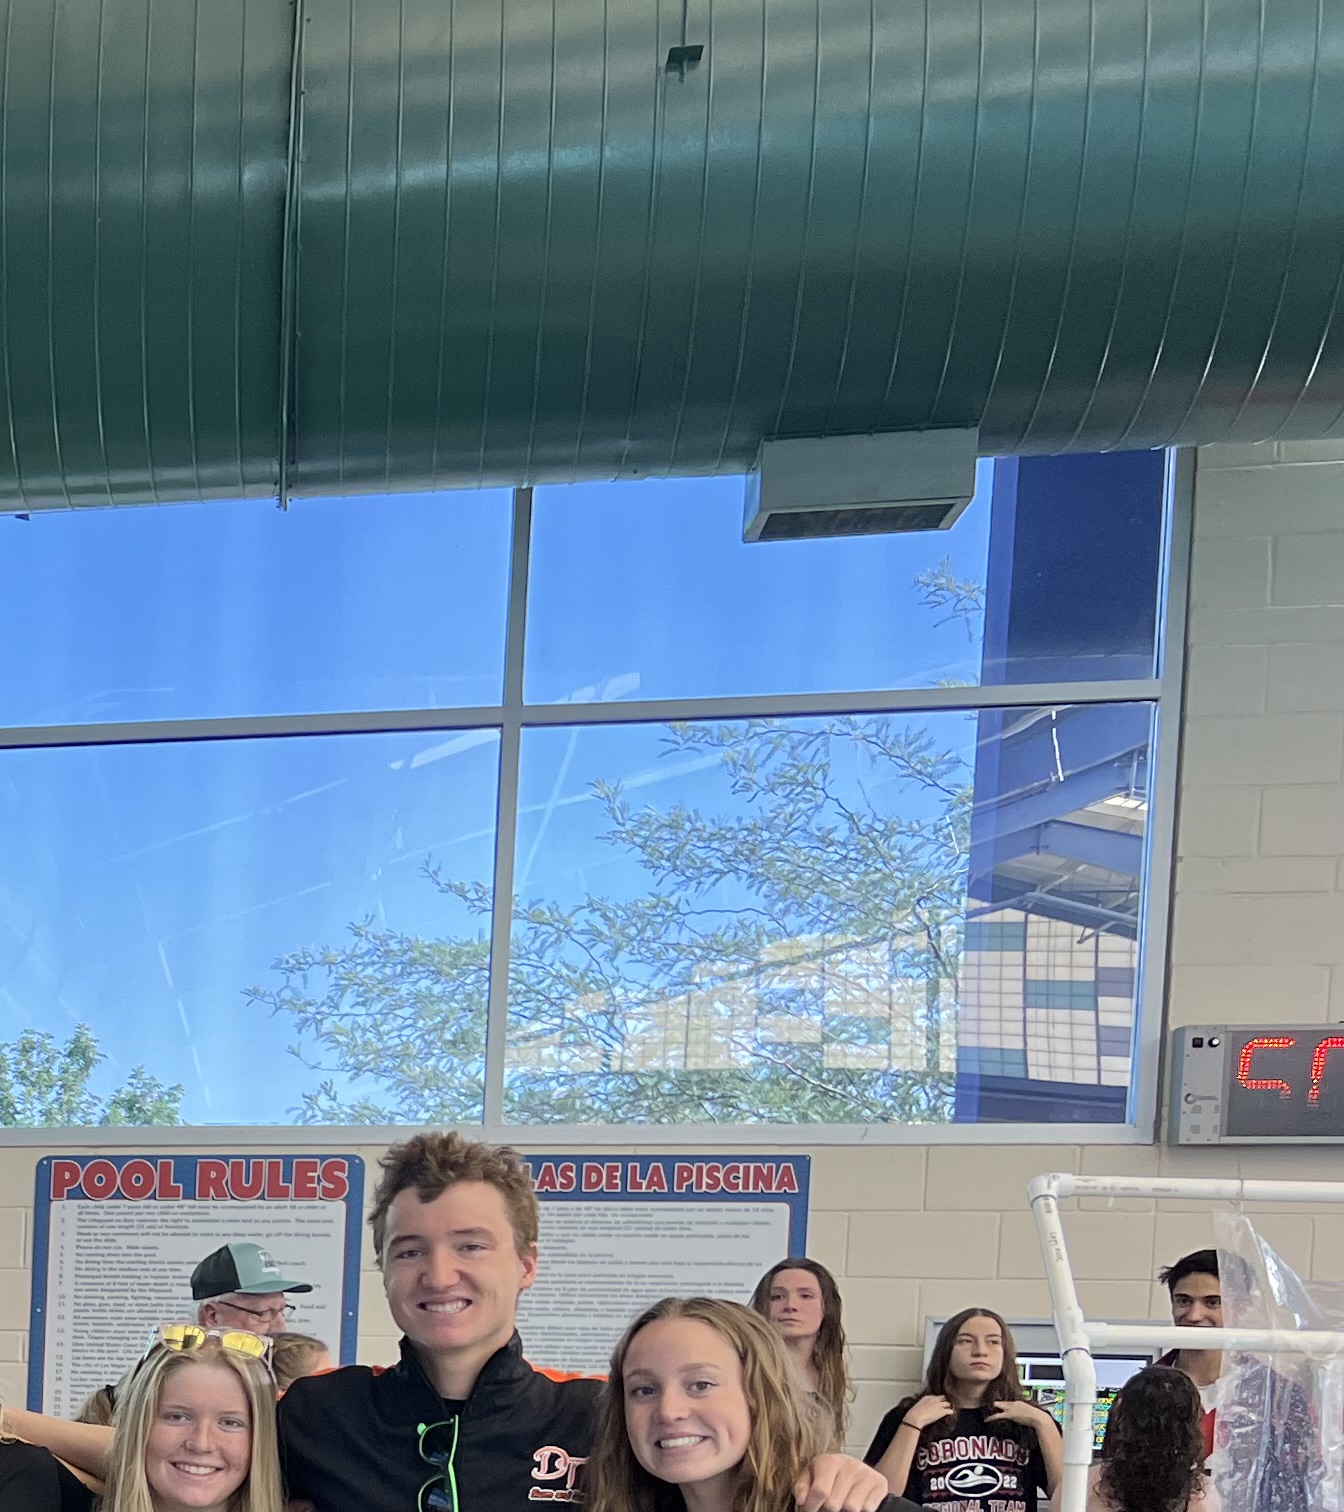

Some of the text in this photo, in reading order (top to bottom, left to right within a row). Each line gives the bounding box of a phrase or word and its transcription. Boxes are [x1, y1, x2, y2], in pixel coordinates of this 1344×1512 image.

[50, 1158, 350, 1201] POOL RULES
[581, 1162, 621, 1194] DE
[627, 1162, 668, 1194] LA
[673, 1162, 800, 1194] PISCINA
[916, 1436, 1029, 1470] CORONADO
[930, 1475, 1018, 1490] 20 22
